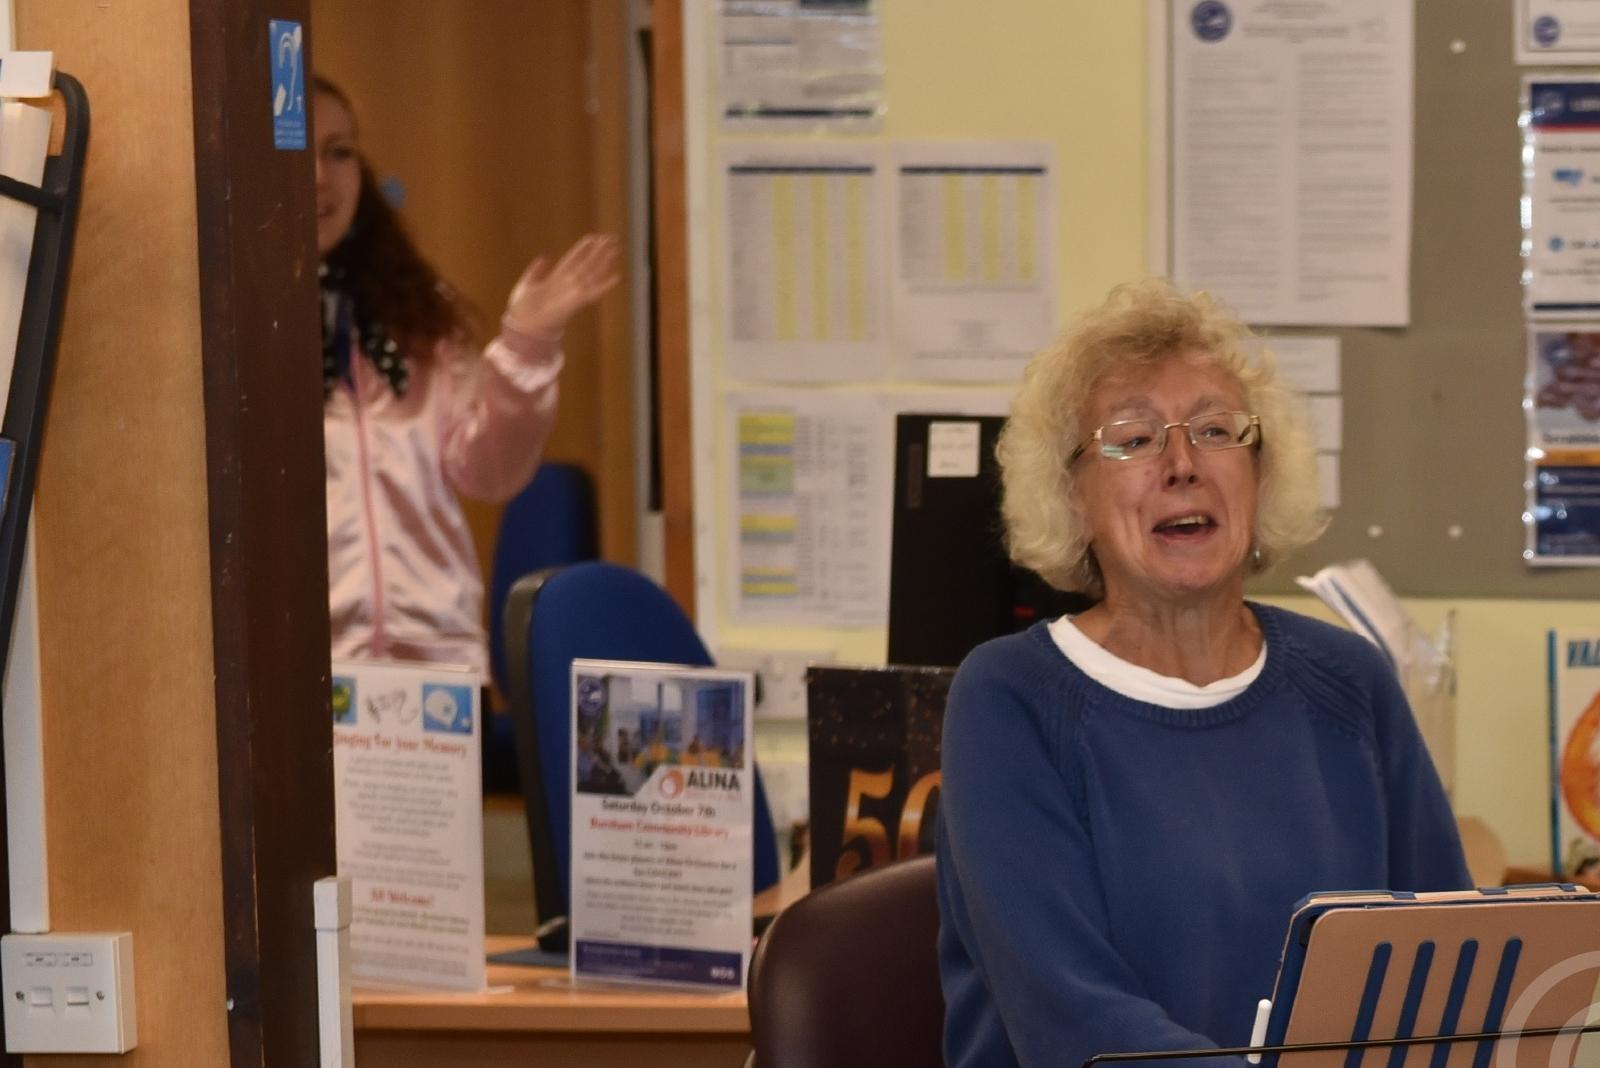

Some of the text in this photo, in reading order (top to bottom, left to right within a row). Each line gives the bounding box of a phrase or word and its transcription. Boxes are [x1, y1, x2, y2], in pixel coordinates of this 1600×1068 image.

[687, 769, 741, 791] ALINA
[602, 798, 649, 814] Saturday
[651, 800, 695, 816] October
